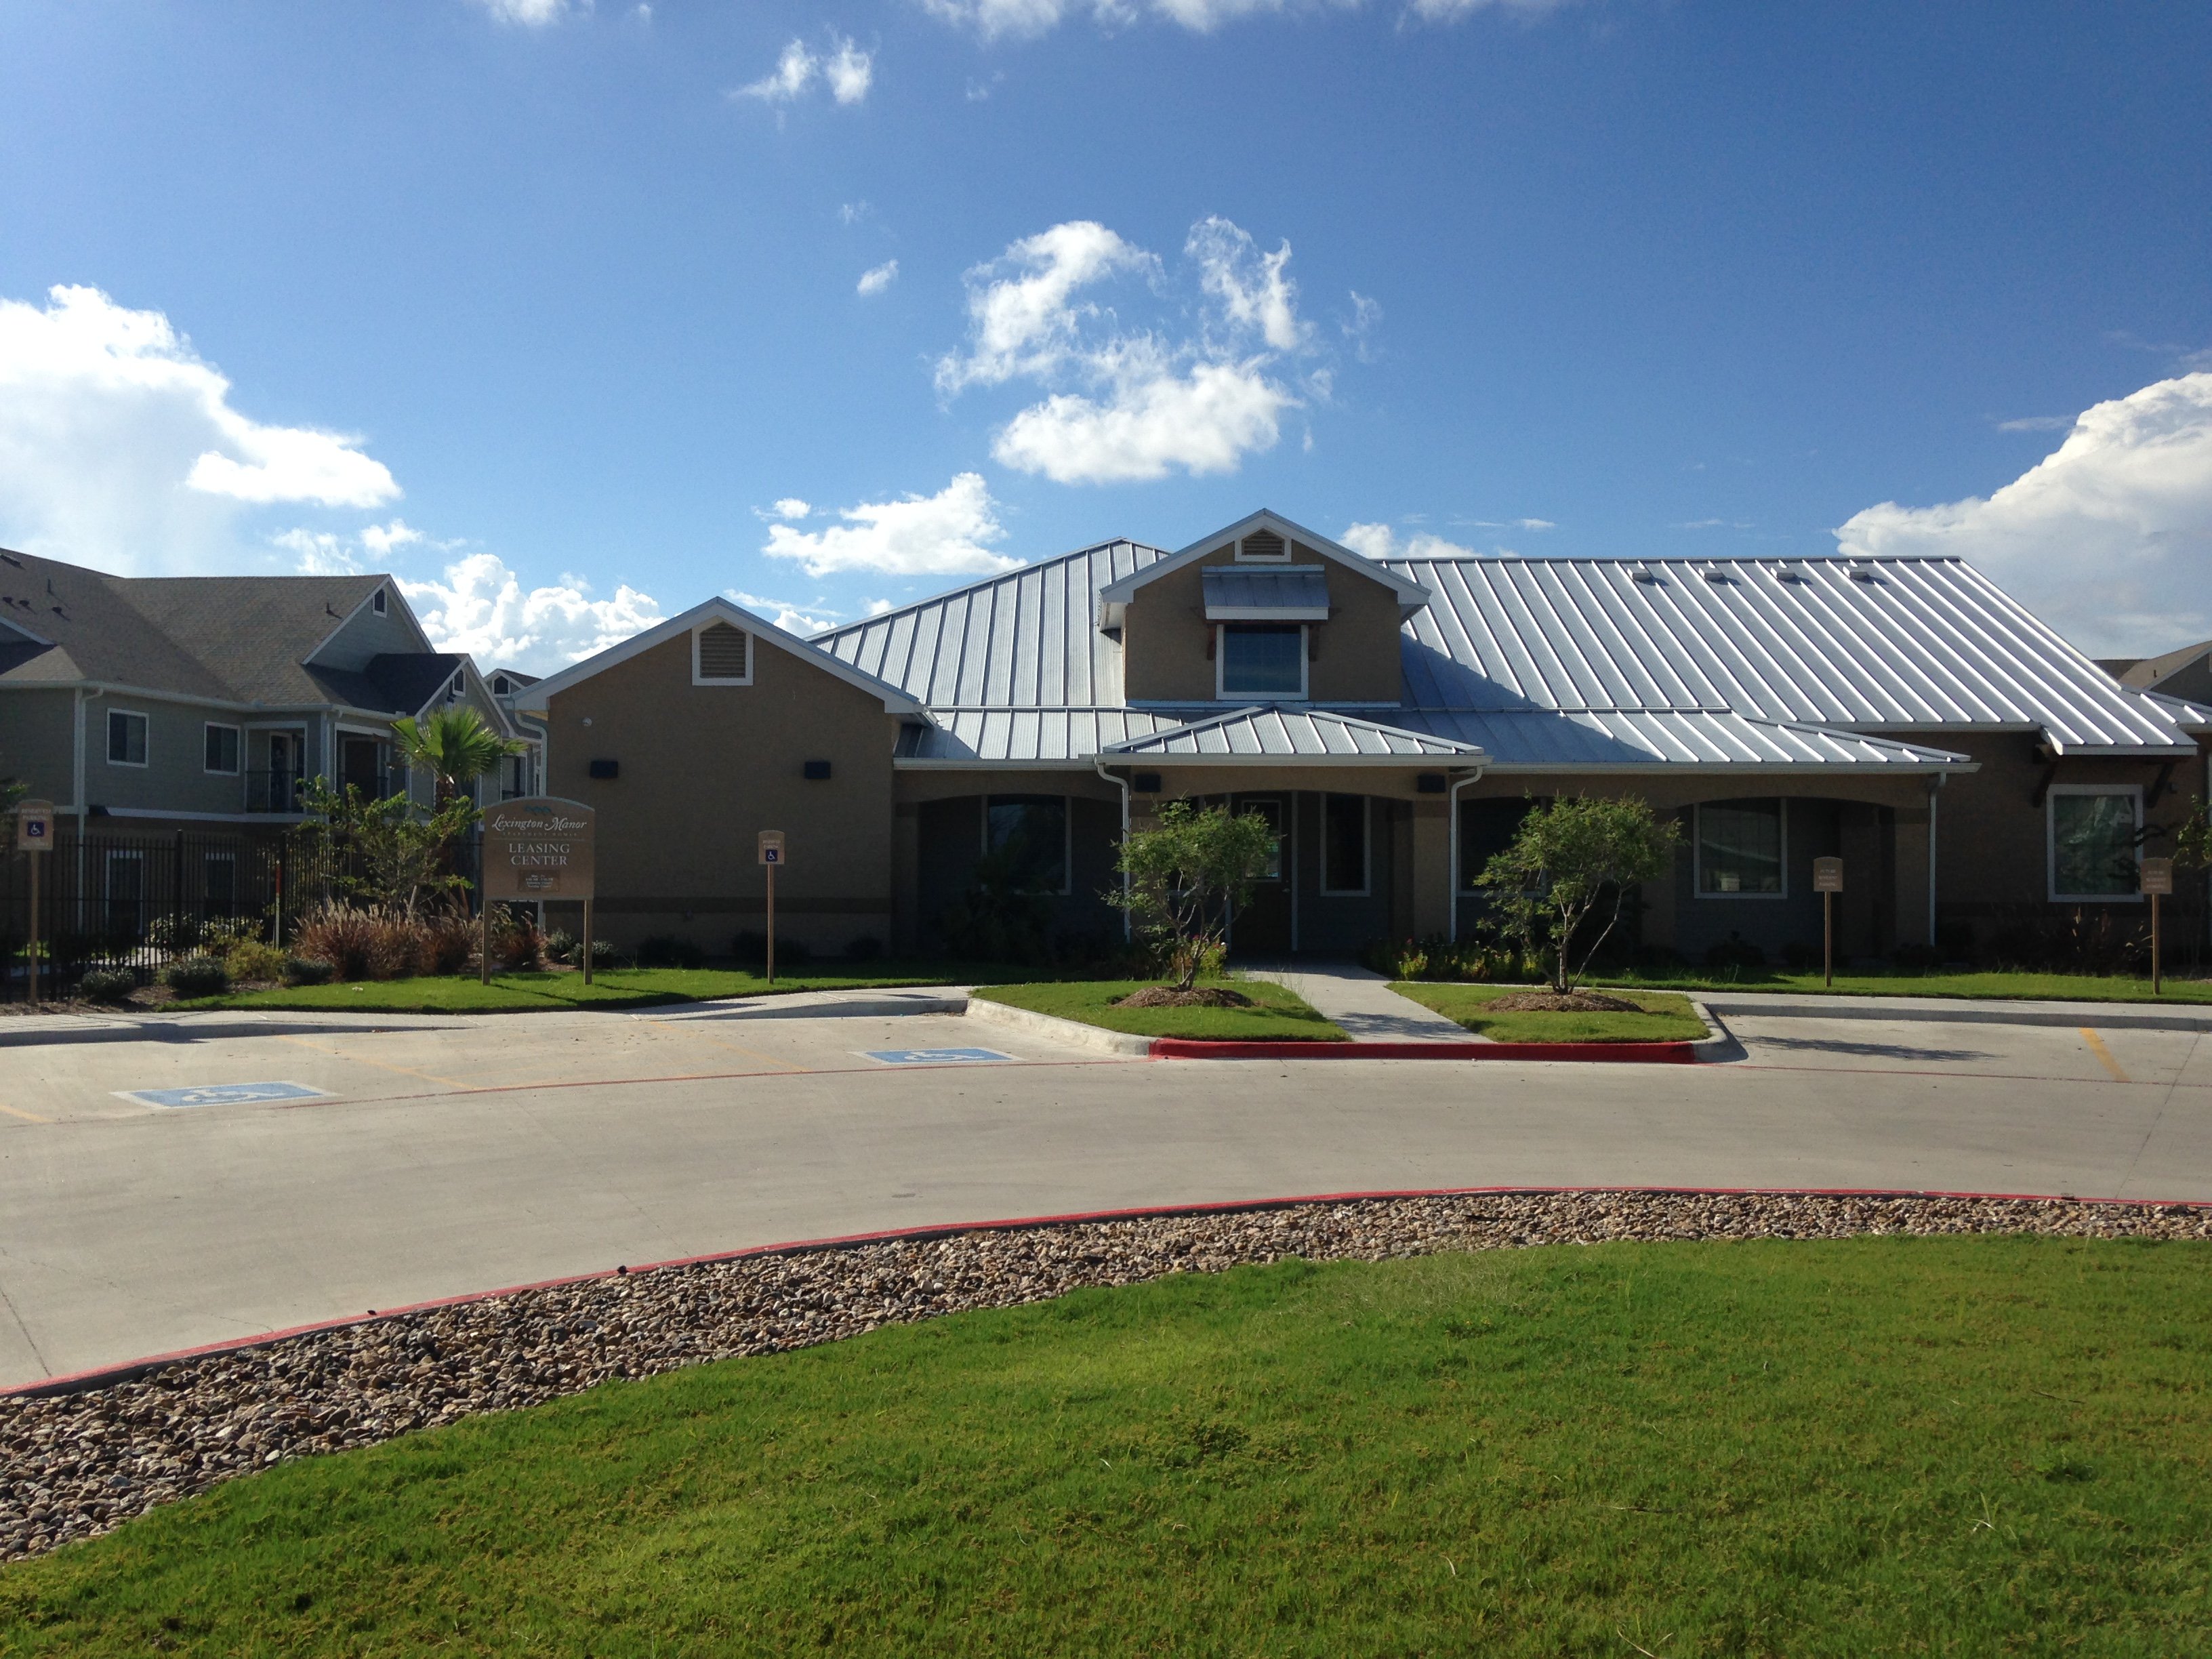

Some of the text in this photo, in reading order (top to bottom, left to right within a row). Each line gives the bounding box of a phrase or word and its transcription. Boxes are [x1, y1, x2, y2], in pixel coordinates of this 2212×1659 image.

[492, 814, 587, 831] Lexington Manor
[509, 843, 569, 853] LEASING
[511, 855, 568, 865] CENTER
